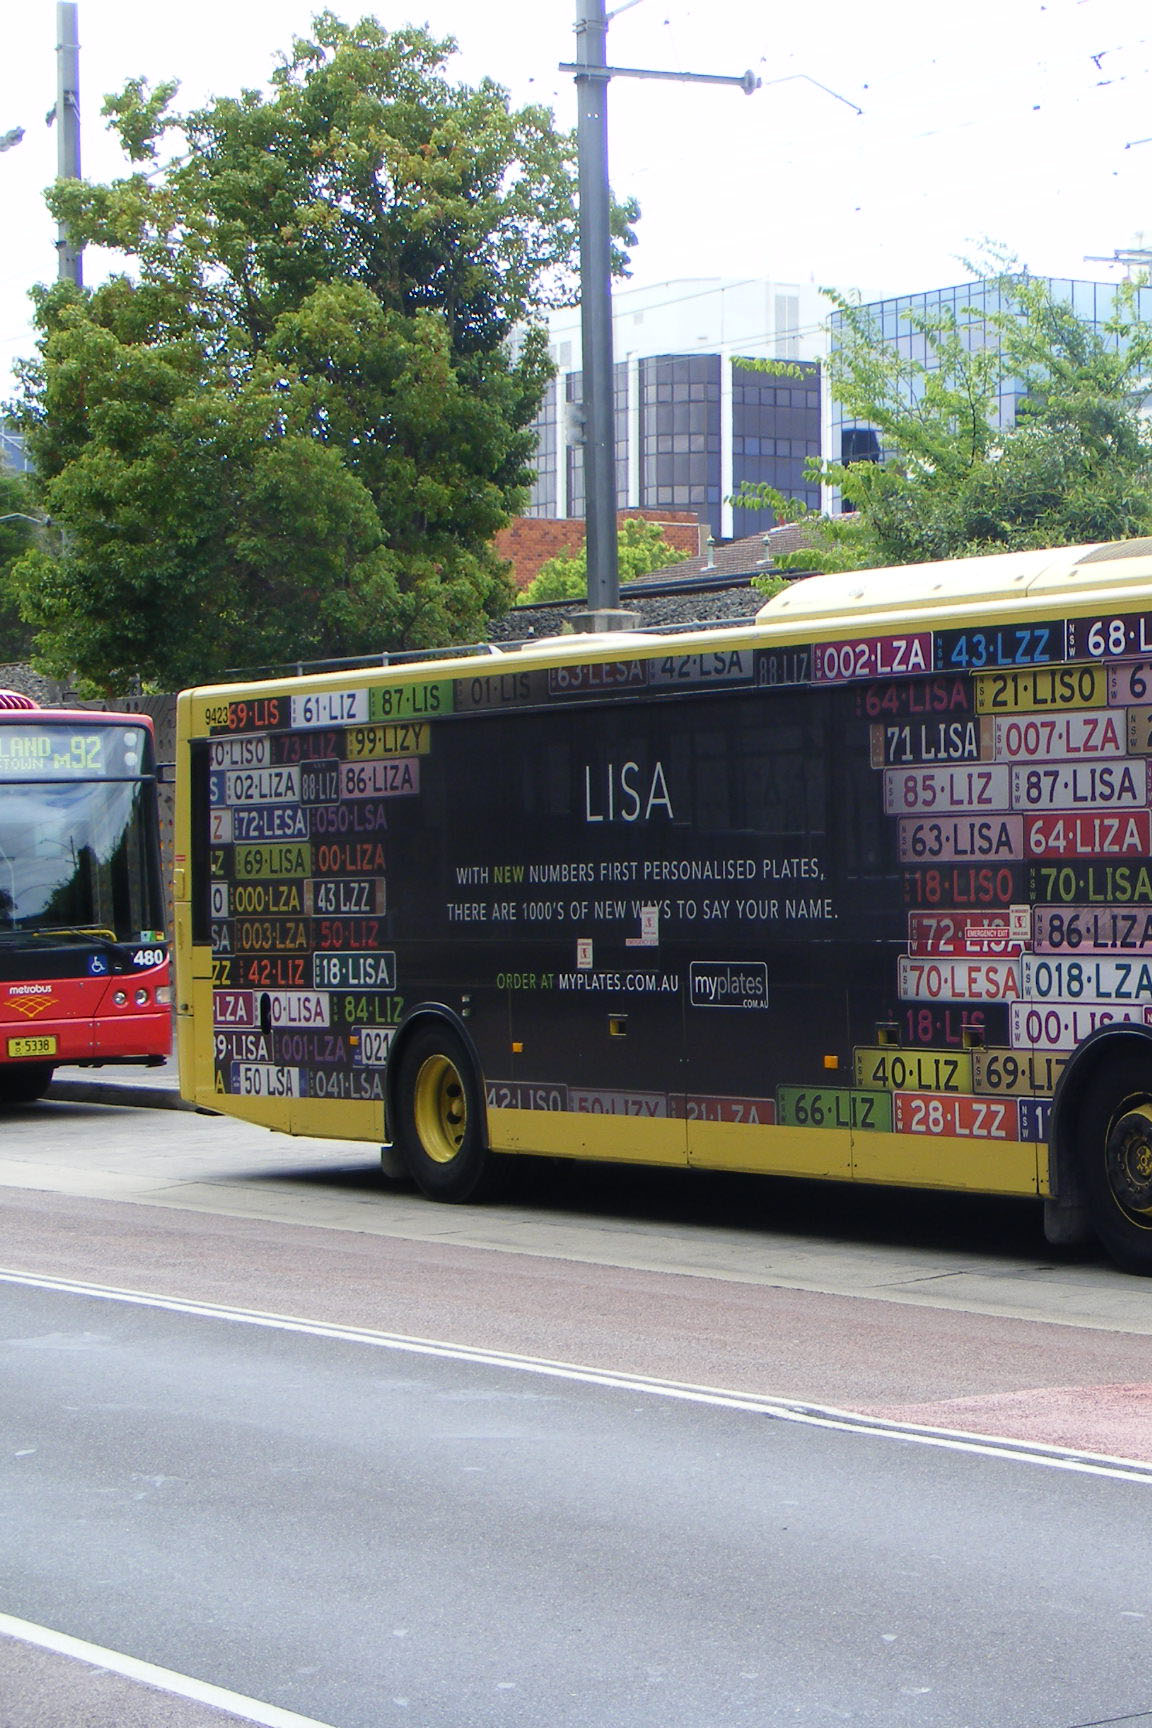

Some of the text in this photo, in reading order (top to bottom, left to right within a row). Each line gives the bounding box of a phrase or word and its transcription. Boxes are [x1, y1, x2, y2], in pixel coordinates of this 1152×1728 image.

[1068, 623, 1076, 657] NSW
[206, 706, 229, 726] 9423
[921, 721, 978, 760] LISA
[586, 762, 674, 823] LISA
[456, 857, 825, 884] WITH NEW NUMBERS FIRST PERSONALISED PLATES,
[447, 903, 487, 921] THERE
[491, 902, 517, 920] ARE
[522, 901, 565, 921] 1000'S
[570, 901, 589, 920] OF
[594, 900, 627, 919] NEW
[676, 899, 697, 919] TO
[702, 899, 730, 919] SAY
[736, 899, 779, 919] YOUR
[784, 898, 839, 919] NAME.
[133, 949, 164, 967] 480
[9, 985, 53, 995] metrobus
[496, 973, 679, 992] ORDER AT MYPLATES.COM.AU
[695, 967, 763, 1000] myplates
[24, 1039, 50, 1052] 5338
